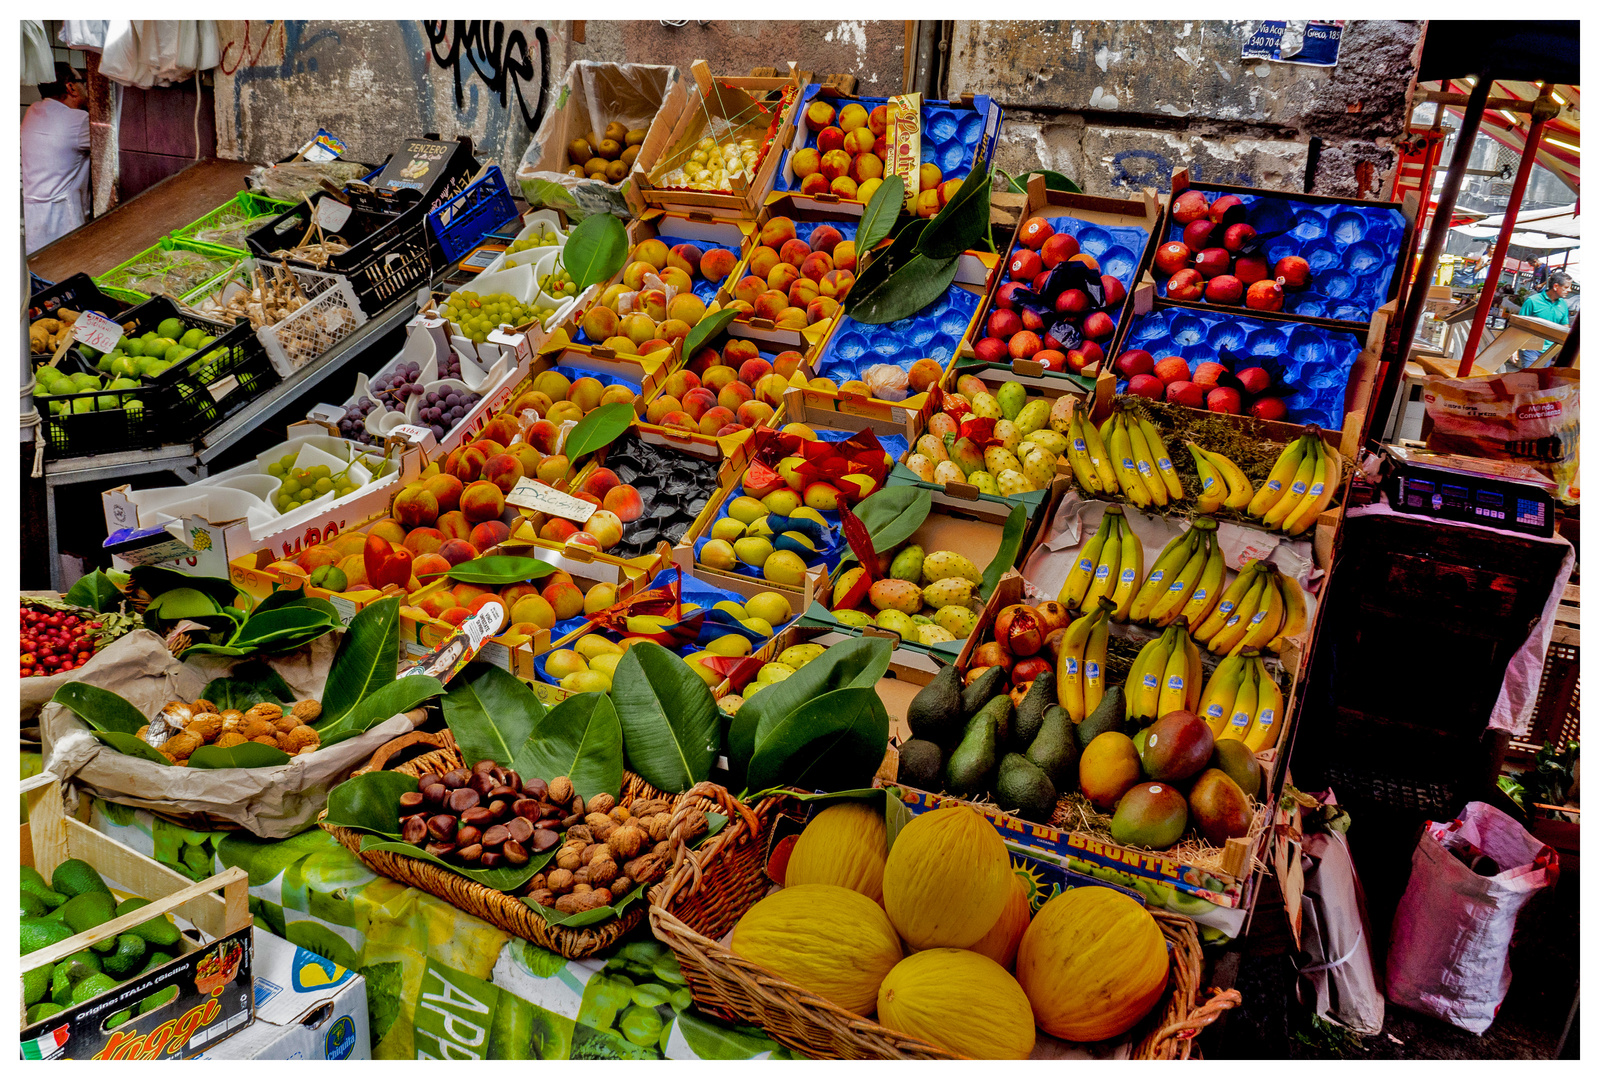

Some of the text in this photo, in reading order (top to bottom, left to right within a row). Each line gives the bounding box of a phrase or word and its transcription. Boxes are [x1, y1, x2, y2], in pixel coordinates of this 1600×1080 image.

[1328, 30, 1340, 40] 185
[407, 142, 448, 155] ZENZERO
[1518, 409, 1562, 420] Convenienza
[75, 962, 190, 1021] Origine: ITALIA (Sicilia)
[416, 966, 491, 1060] APP
